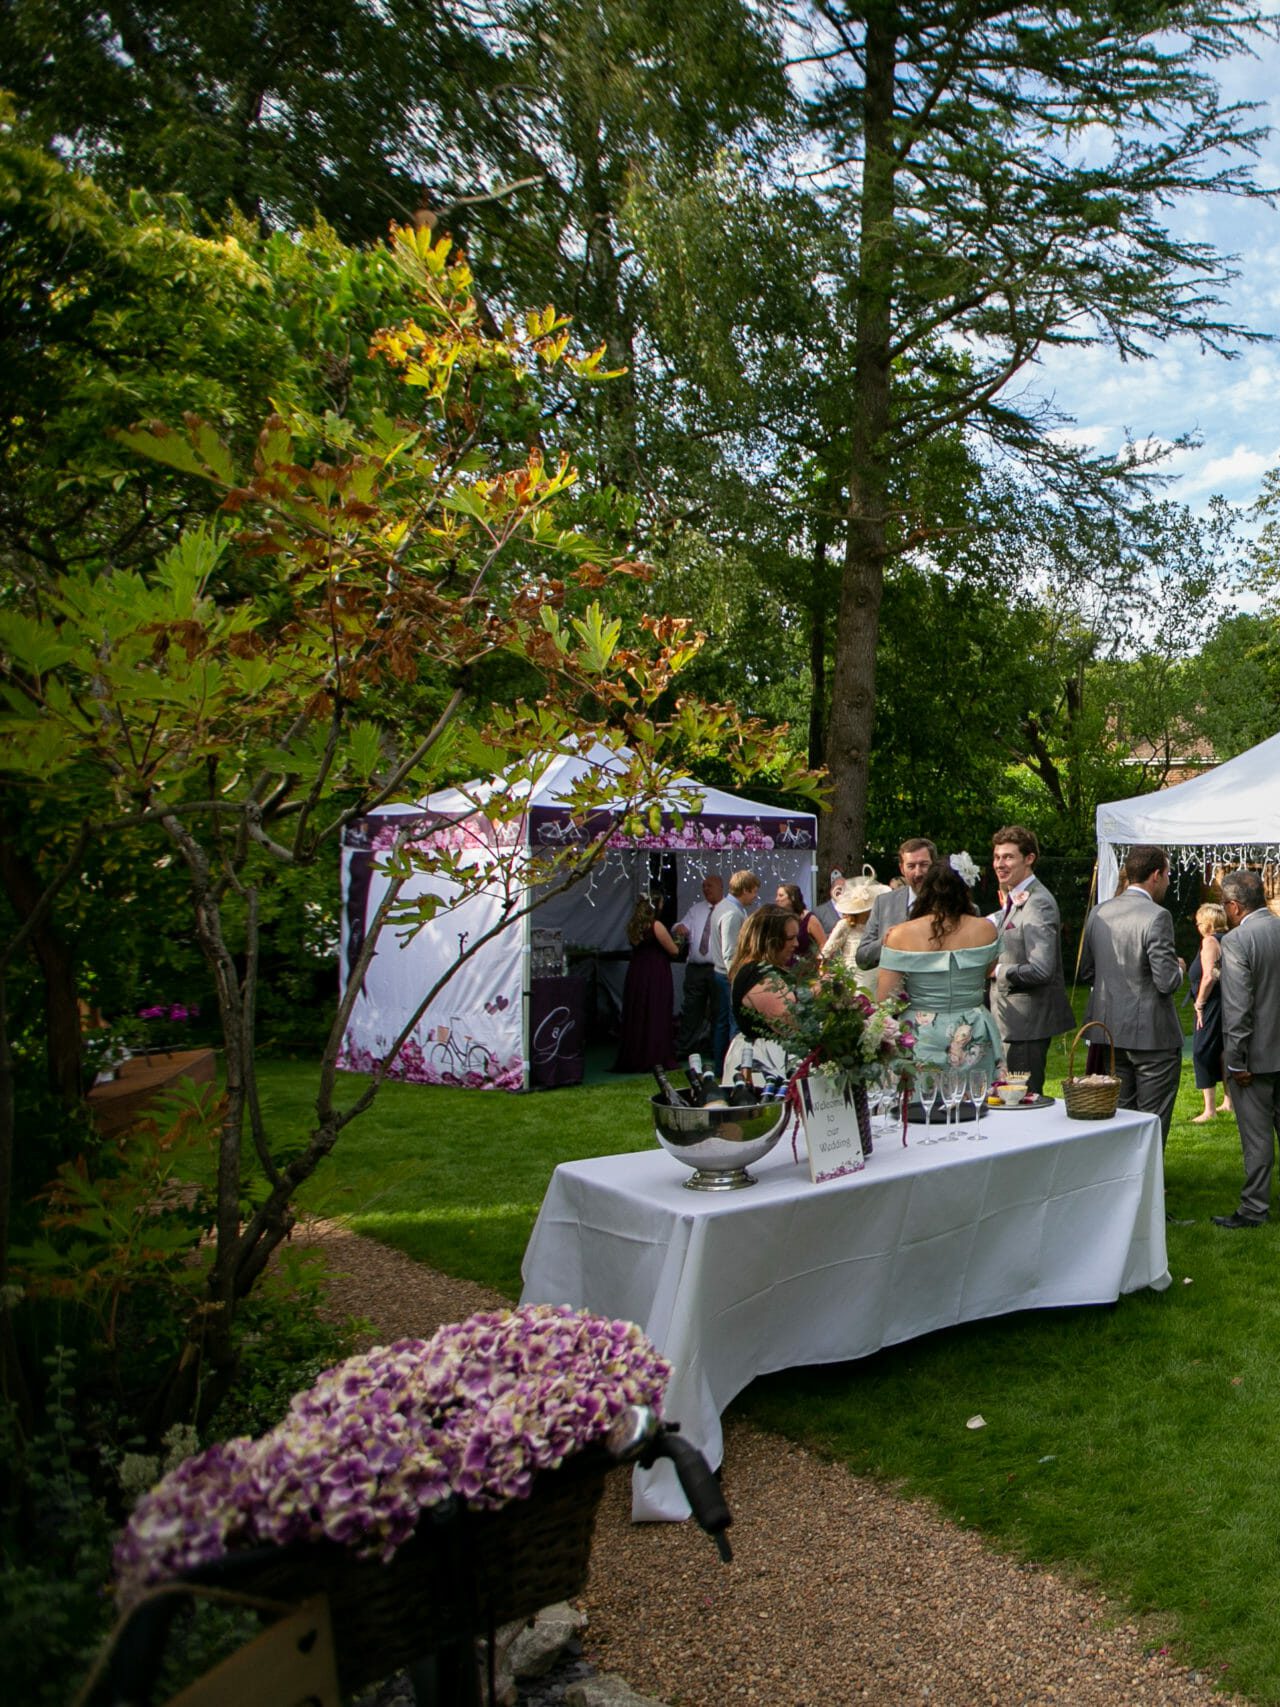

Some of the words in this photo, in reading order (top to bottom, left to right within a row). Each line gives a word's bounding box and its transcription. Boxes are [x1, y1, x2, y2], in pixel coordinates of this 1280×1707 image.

[814, 1100, 843, 1111] Welcome
[827, 1114, 835, 1122] to
[827, 1127, 839, 1137] our
[819, 1138, 851, 1153] Wedding
